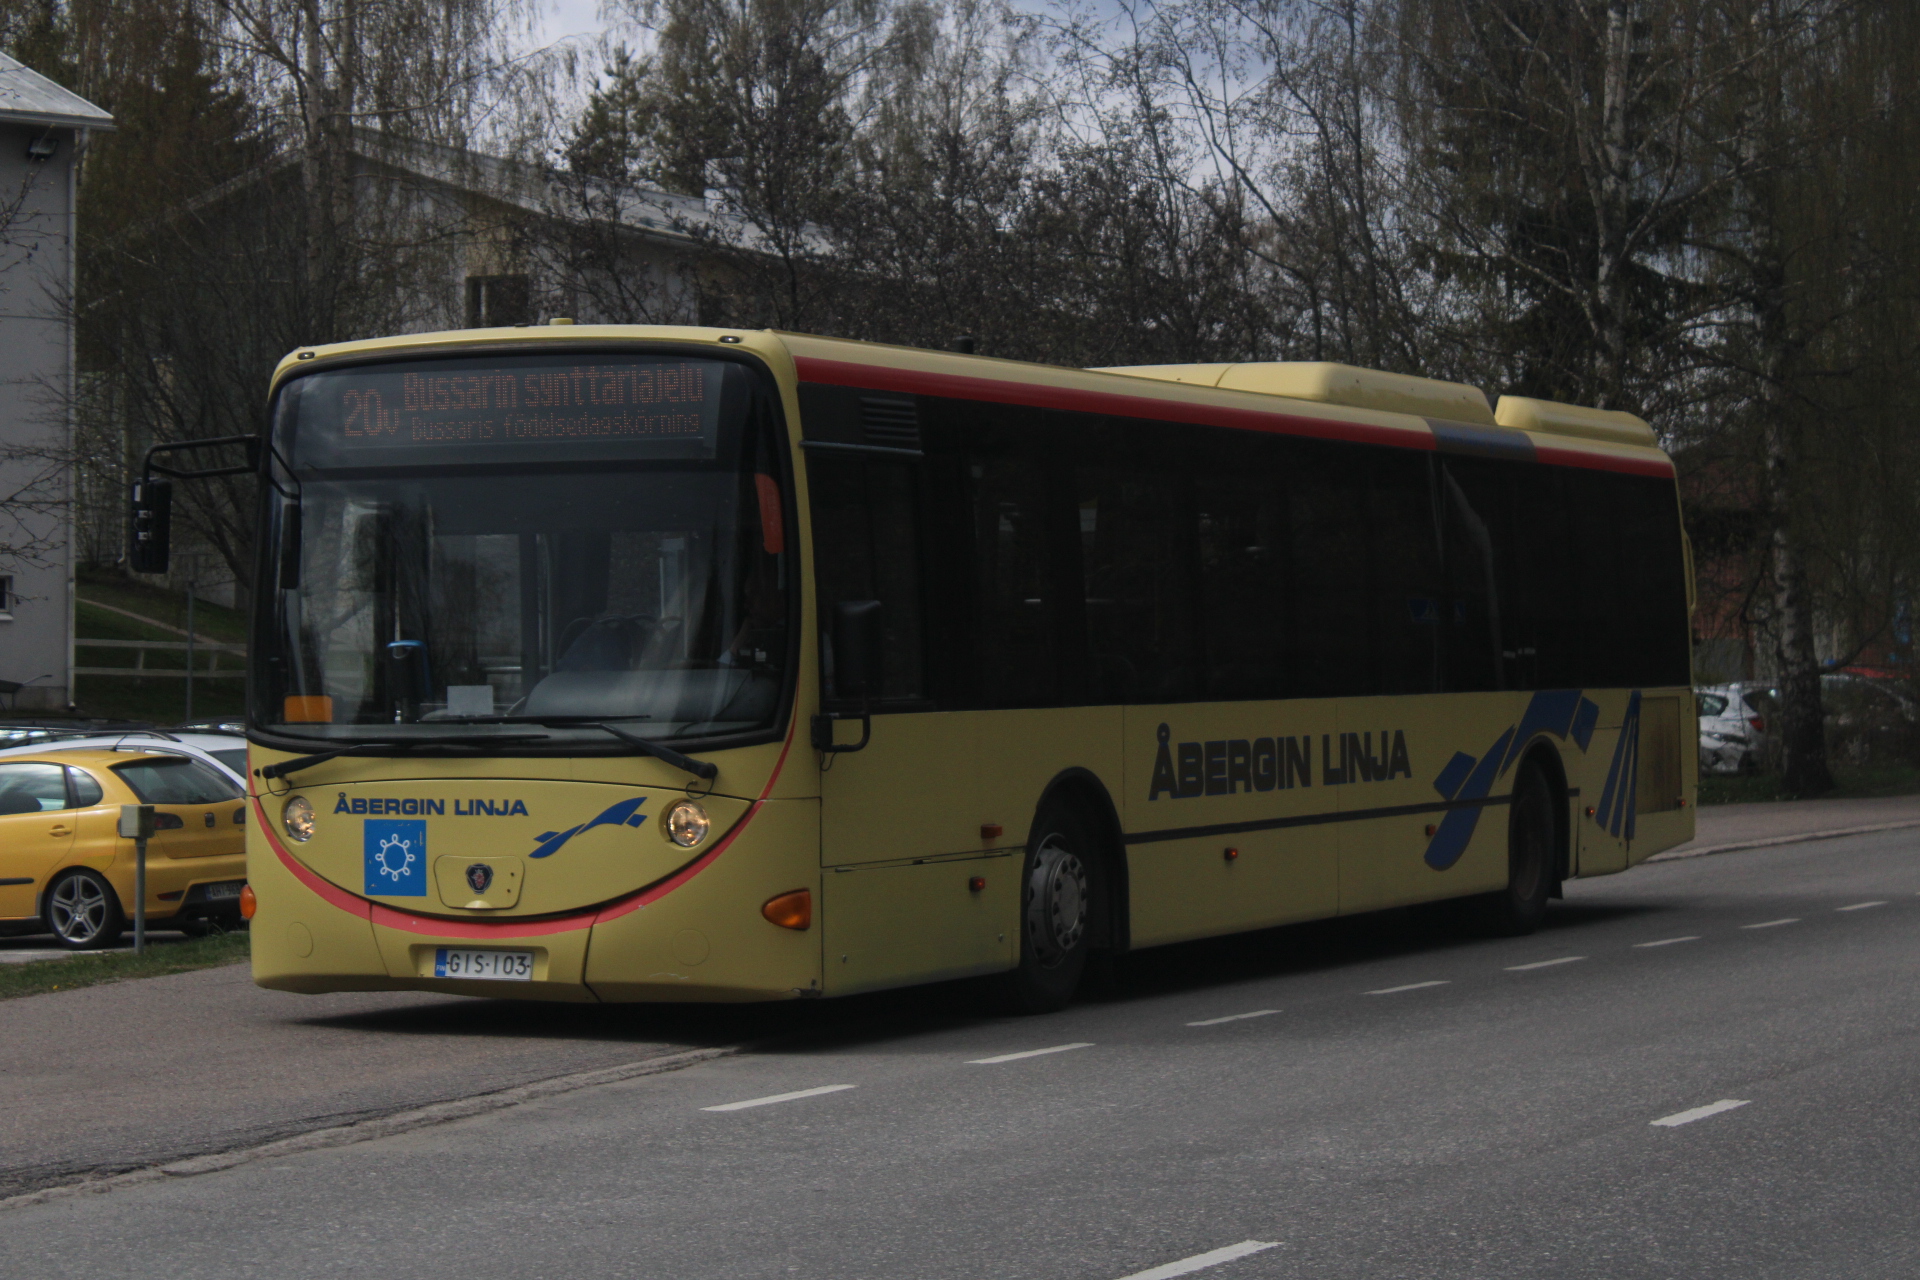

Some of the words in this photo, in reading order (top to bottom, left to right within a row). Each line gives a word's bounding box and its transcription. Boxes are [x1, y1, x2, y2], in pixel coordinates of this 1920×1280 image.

[403, 369, 517, 411] Bussarin
[411, 415, 493, 441] Bussaris
[1148, 722, 1312, 802] ÅBERGIN
[1322, 729, 1412, 785] LINJA
[333, 792, 445, 816] ÅBERGIN
[454, 798, 529, 817] LINJA
